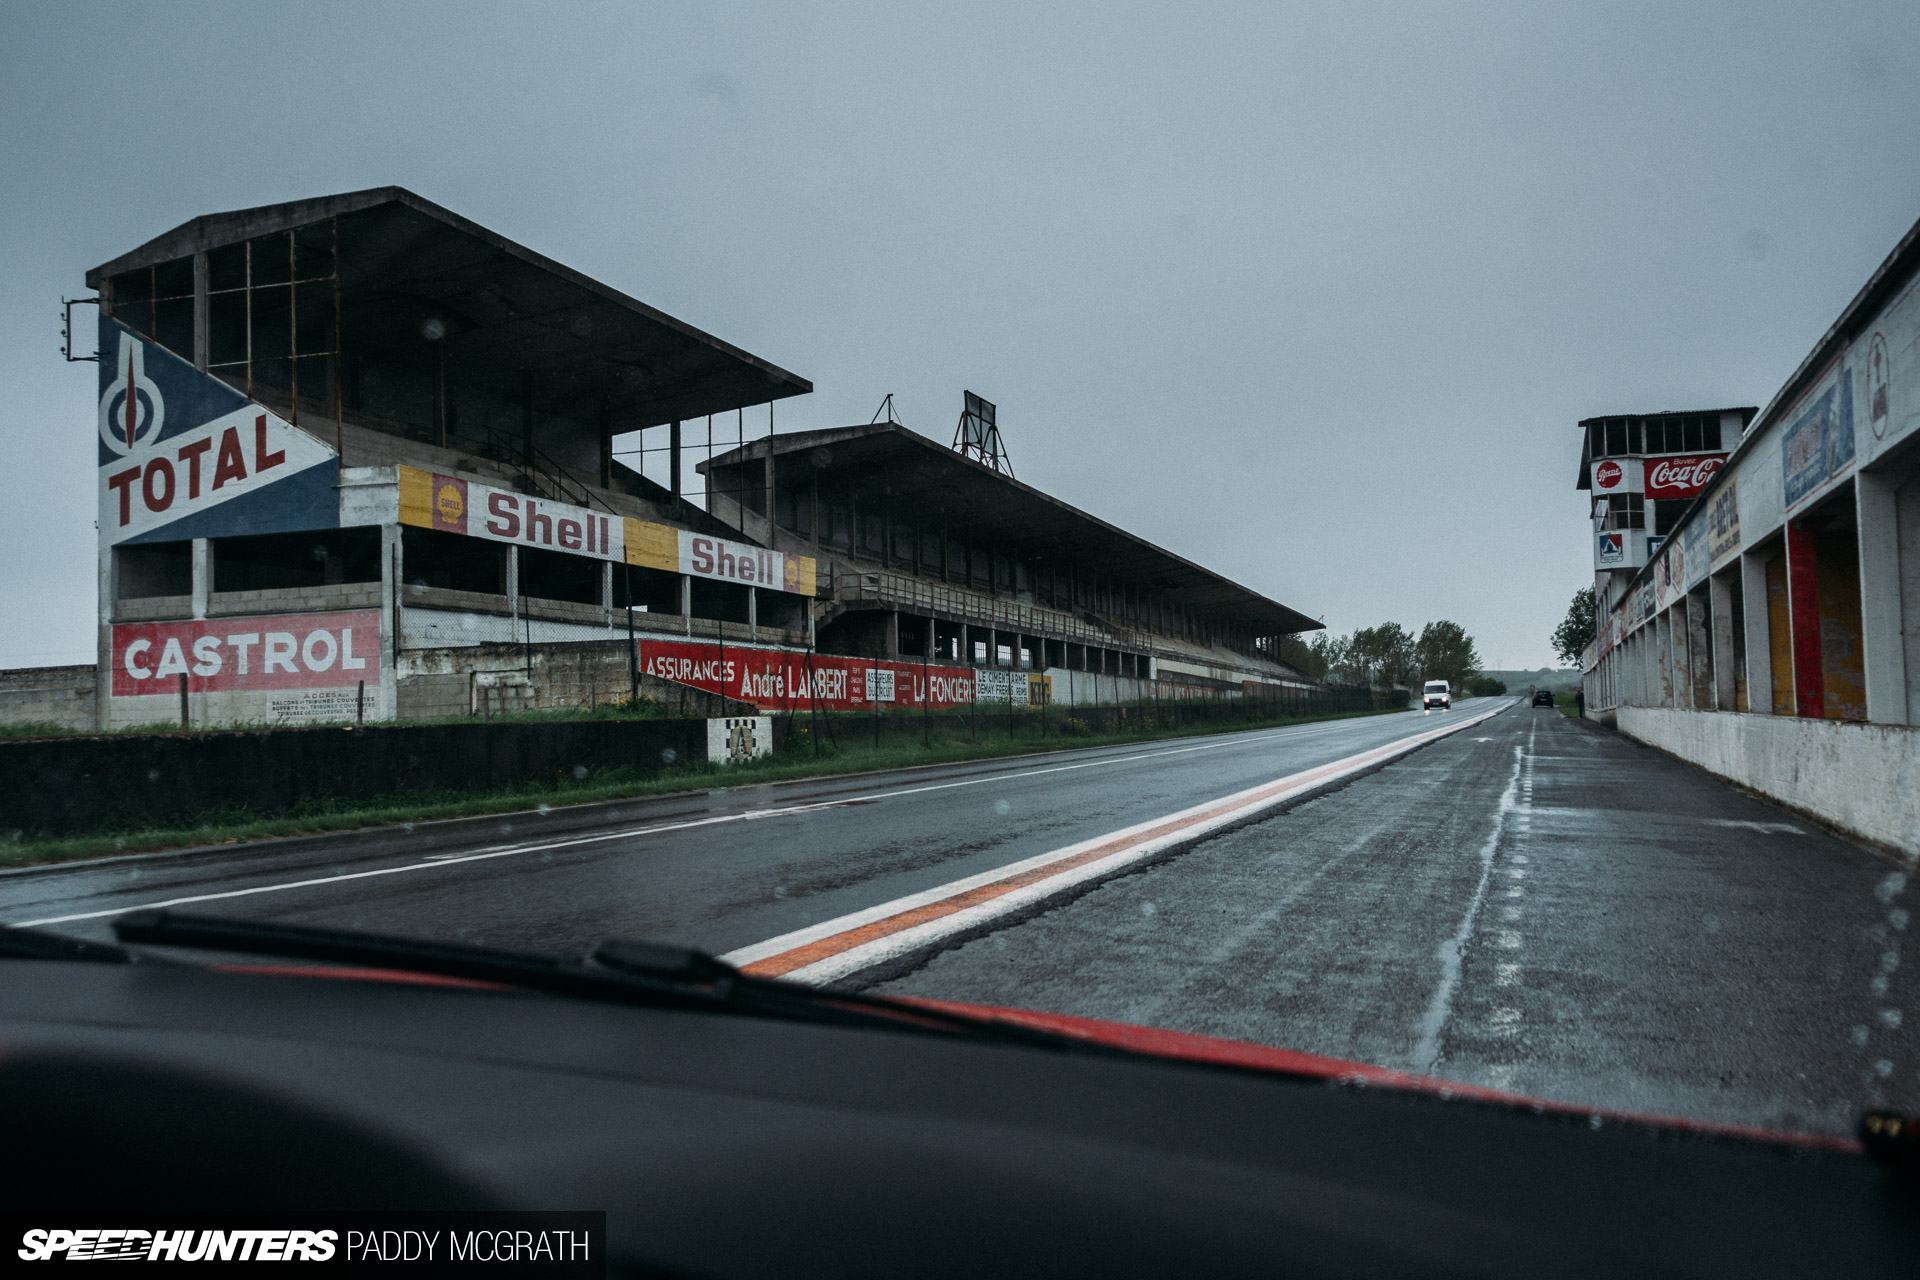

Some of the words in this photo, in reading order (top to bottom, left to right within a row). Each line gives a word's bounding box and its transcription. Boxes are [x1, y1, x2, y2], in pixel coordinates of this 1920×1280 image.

[108, 413, 286, 528] TOTAL
[1650, 458, 1724, 489] Coca-C
[1673, 457, 1696, 465] Buvez
[441, 498, 460, 510] SHELL
[486, 491, 609, 555] Shell
[691, 537, 773, 586] Shell
[124, 628, 366, 681] CASTROL
[646, 656, 735, 682] ASSURANCES
[740, 662, 784, 697] André
[788, 666, 848, 700] LAMBERT
[867, 672, 894, 684] ASSREURS
[978, 671, 986, 683] LE
[988, 671, 1010, 684] CIMENT
[996, 684, 1014, 696] FRERS
